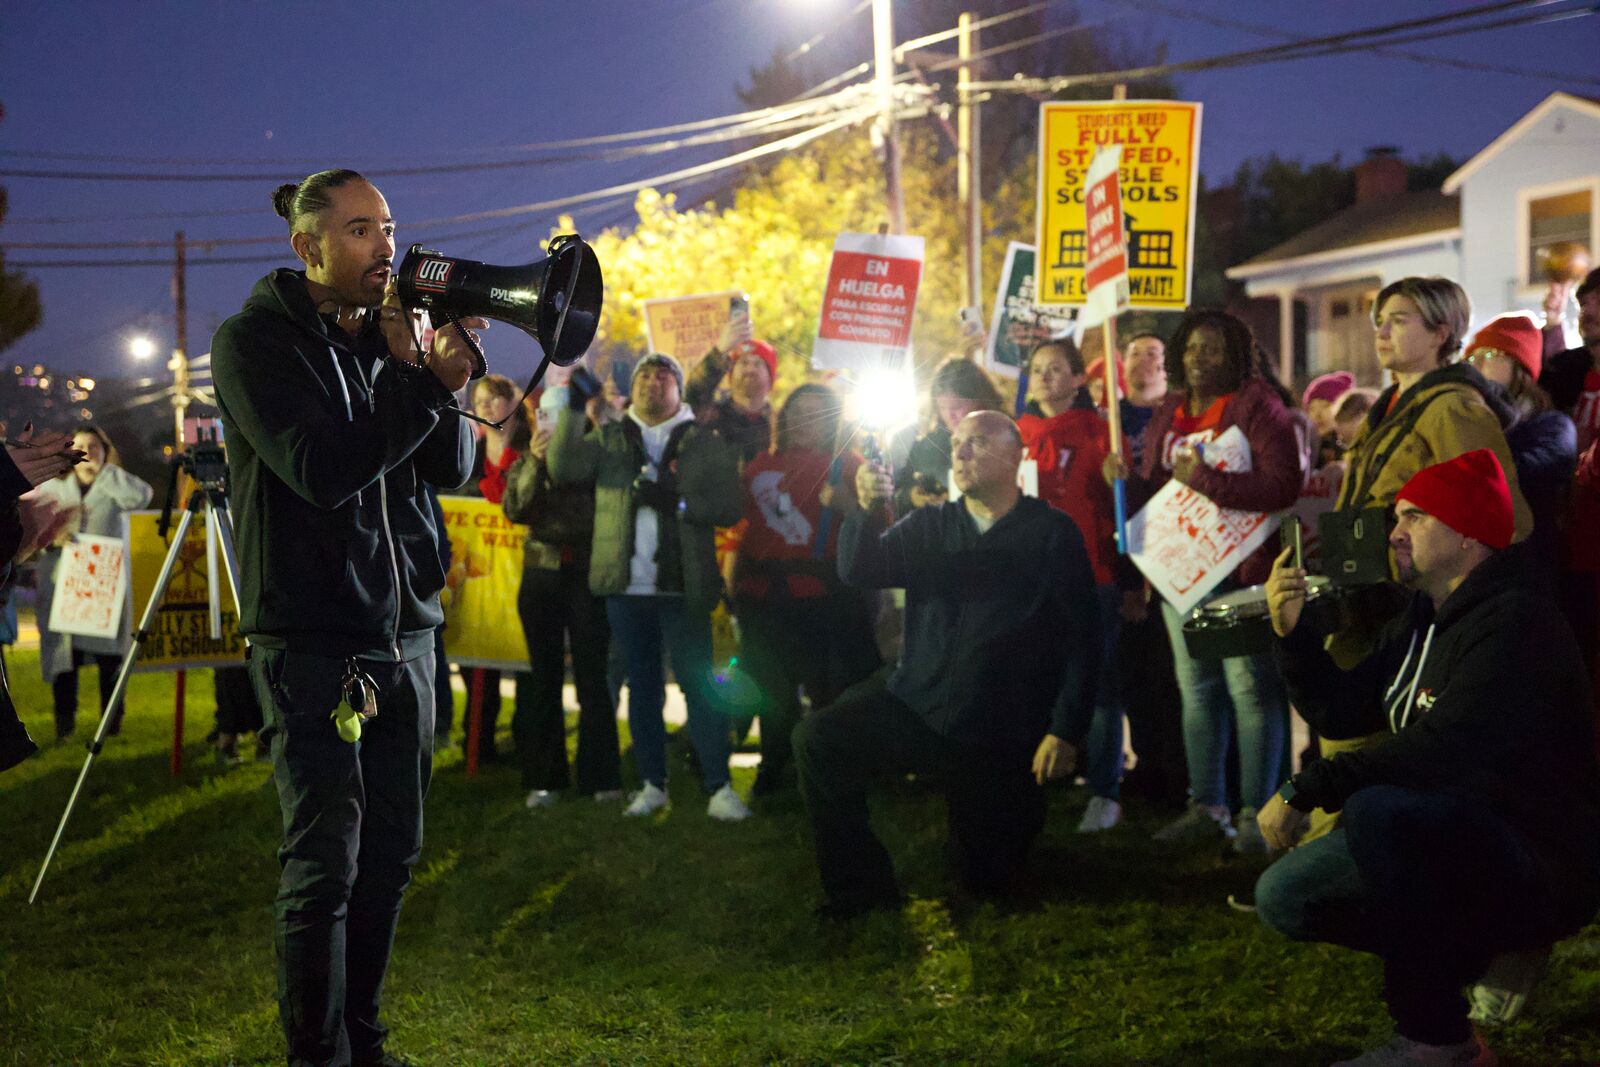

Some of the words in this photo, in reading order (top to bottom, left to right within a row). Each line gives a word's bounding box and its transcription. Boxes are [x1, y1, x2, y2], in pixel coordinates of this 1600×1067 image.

[1077, 113, 1133, 128] STUDENTS
[1137, 111, 1167, 127] NEED
[1078, 128, 1160, 146] FULLY
[1057, 147, 1181, 166] STFED,
[1056, 186, 1179, 204] SCOLS
[419, 259, 450, 282] UTR
[866, 259, 890, 277] EN
[838, 278, 905, 300] HUELGA
[1053, 276, 1075, 297] WE
[1129, 275, 1174, 297] WAIT!
